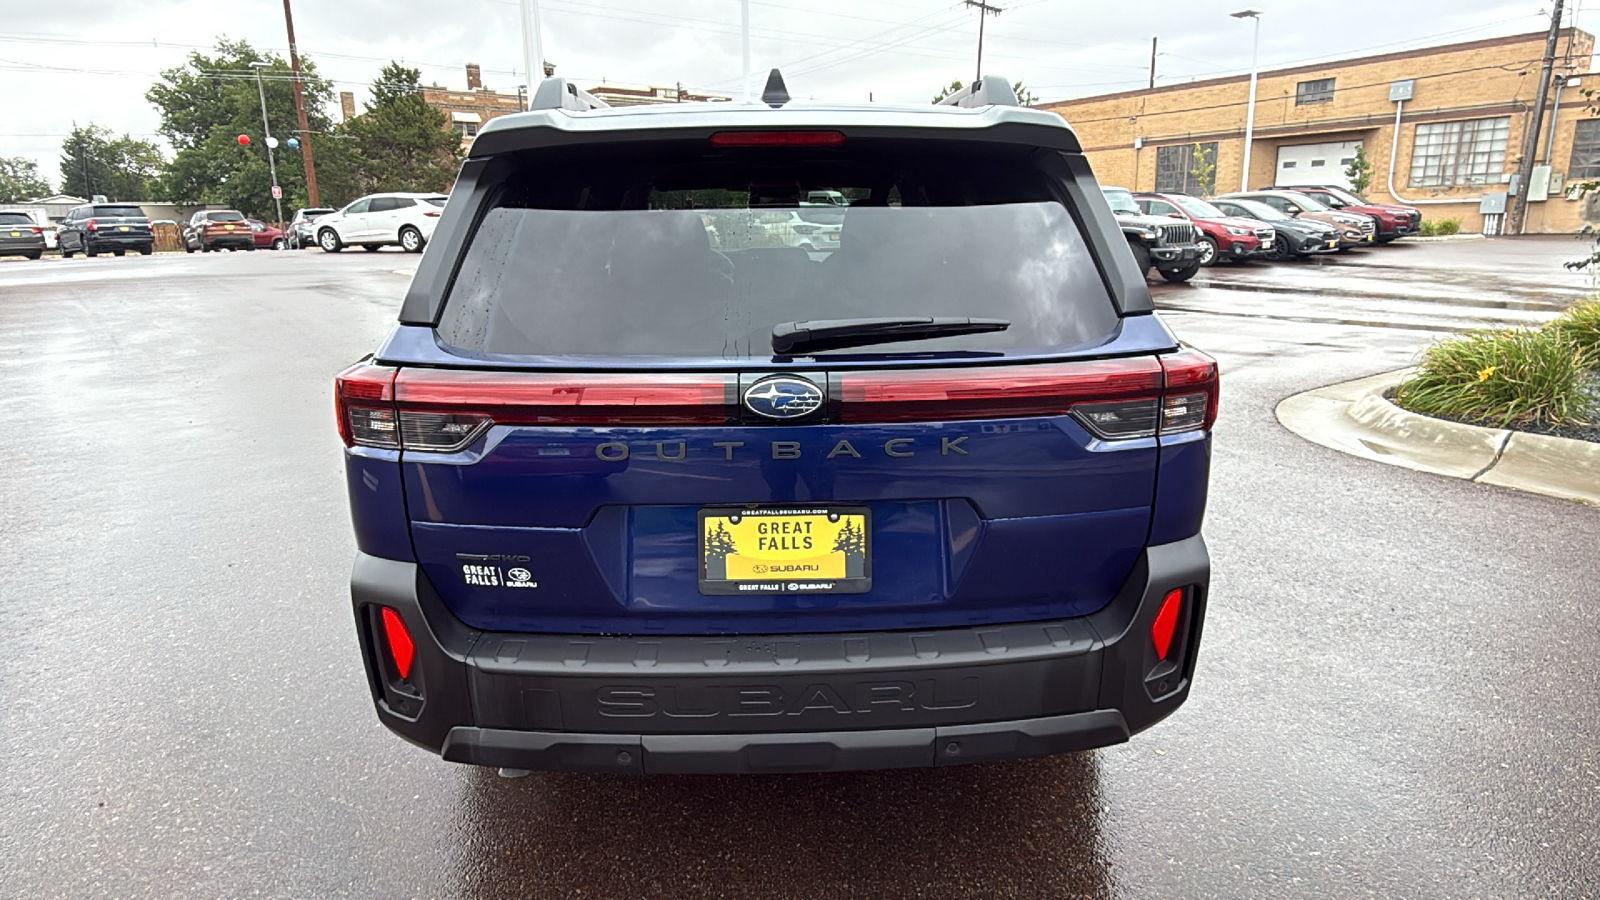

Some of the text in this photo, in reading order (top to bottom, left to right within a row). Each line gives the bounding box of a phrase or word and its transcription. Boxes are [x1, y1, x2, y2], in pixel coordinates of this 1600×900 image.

[595, 435, 969, 463] OUTBACK
[758, 521, 812, 534] GREAT
[758, 536, 813, 551] FALLS
[463, 565, 495, 575] GREAT
[770, 564, 819, 572] SUBARU
[465, 575, 498, 586] FALLS
[596, 676, 980, 717] SUBARU
